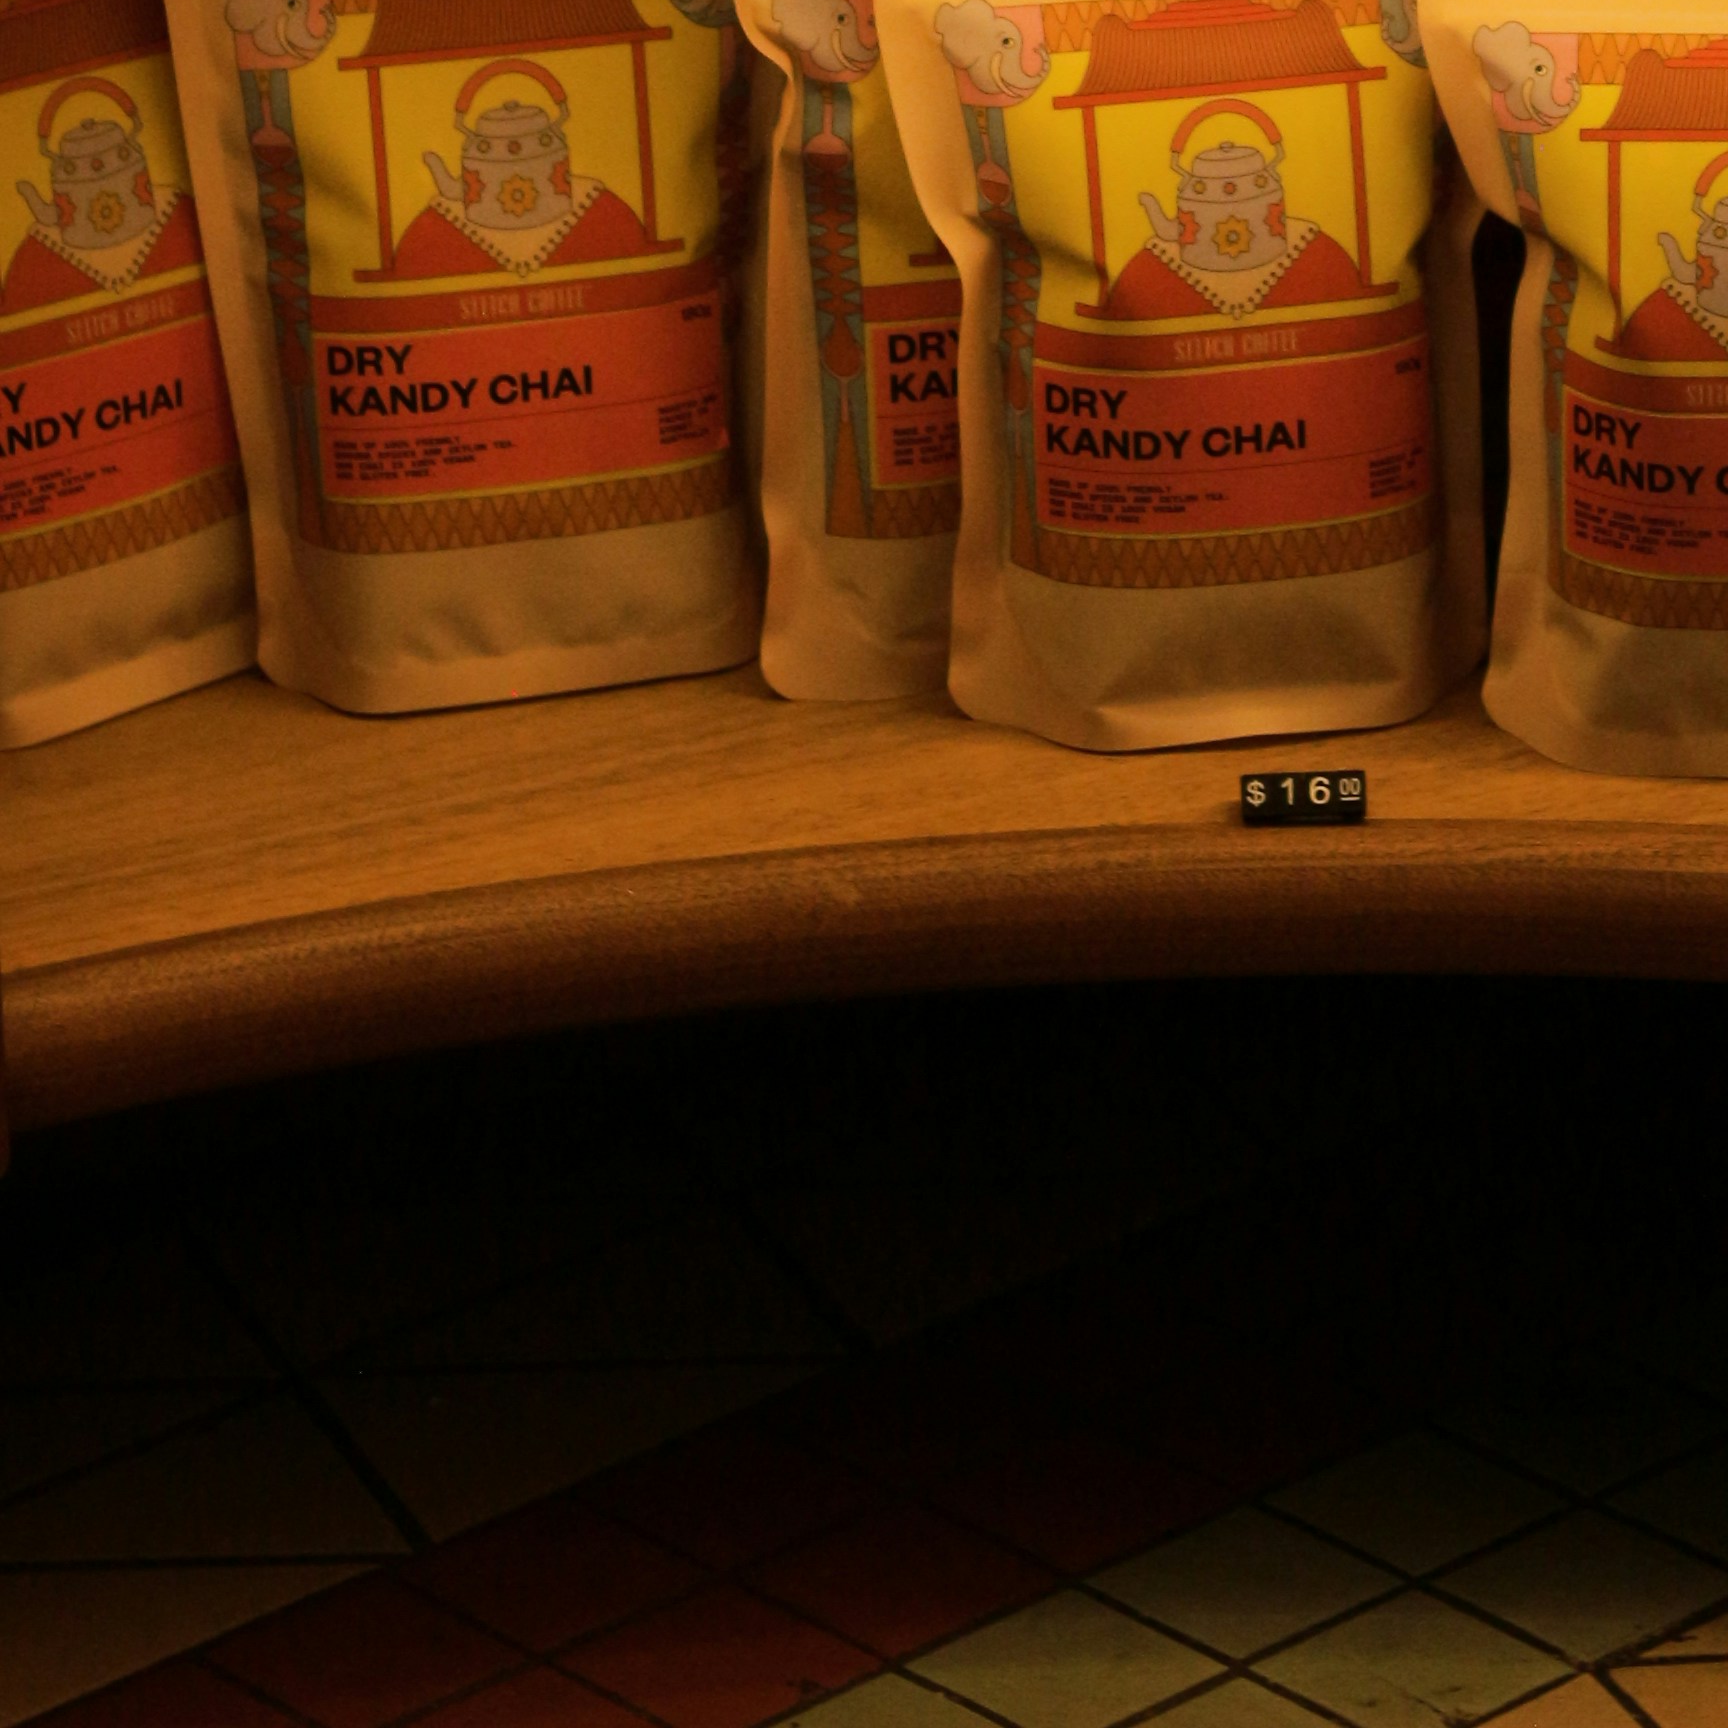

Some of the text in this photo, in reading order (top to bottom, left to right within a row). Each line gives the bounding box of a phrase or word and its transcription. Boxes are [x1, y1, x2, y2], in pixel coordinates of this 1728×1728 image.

[327, 344, 412, 377] DRY
[95, 380, 184, 430] CHAI
[328, 365, 594, 417] KANDY CHAI
[1044, 383, 1127, 420] DRY
[1046, 420, 1306, 460] KANDY CHAI
[1573, 404, 1641, 449] DRY
[1573, 444, 1704, 495] KANDY
